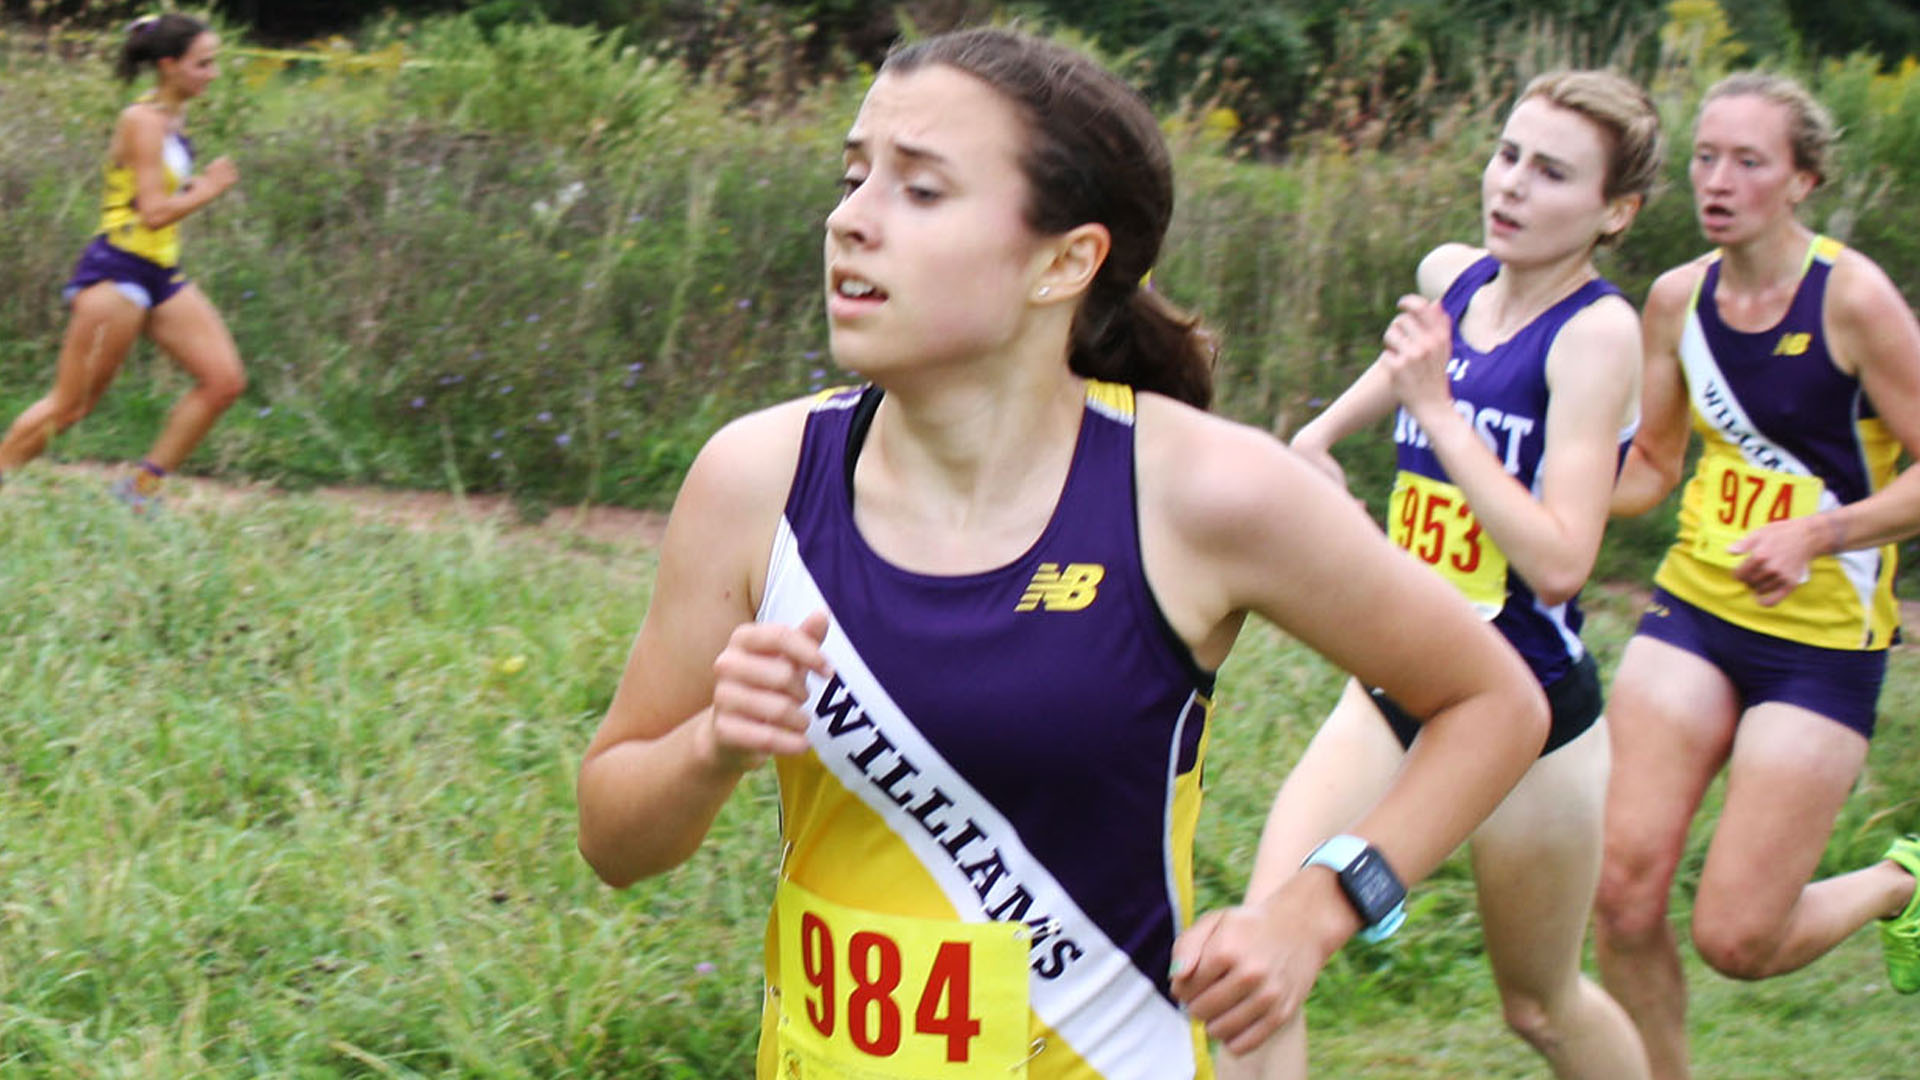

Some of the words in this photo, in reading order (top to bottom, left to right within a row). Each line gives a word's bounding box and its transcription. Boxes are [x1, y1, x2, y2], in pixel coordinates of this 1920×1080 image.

[1398, 486, 1482, 573] 953
[1718, 469, 1794, 530] 974
[1015, 562, 1104, 611] NB
[815, 671, 1084, 981] WILLIAMS
[801, 911, 980, 1063] 984
